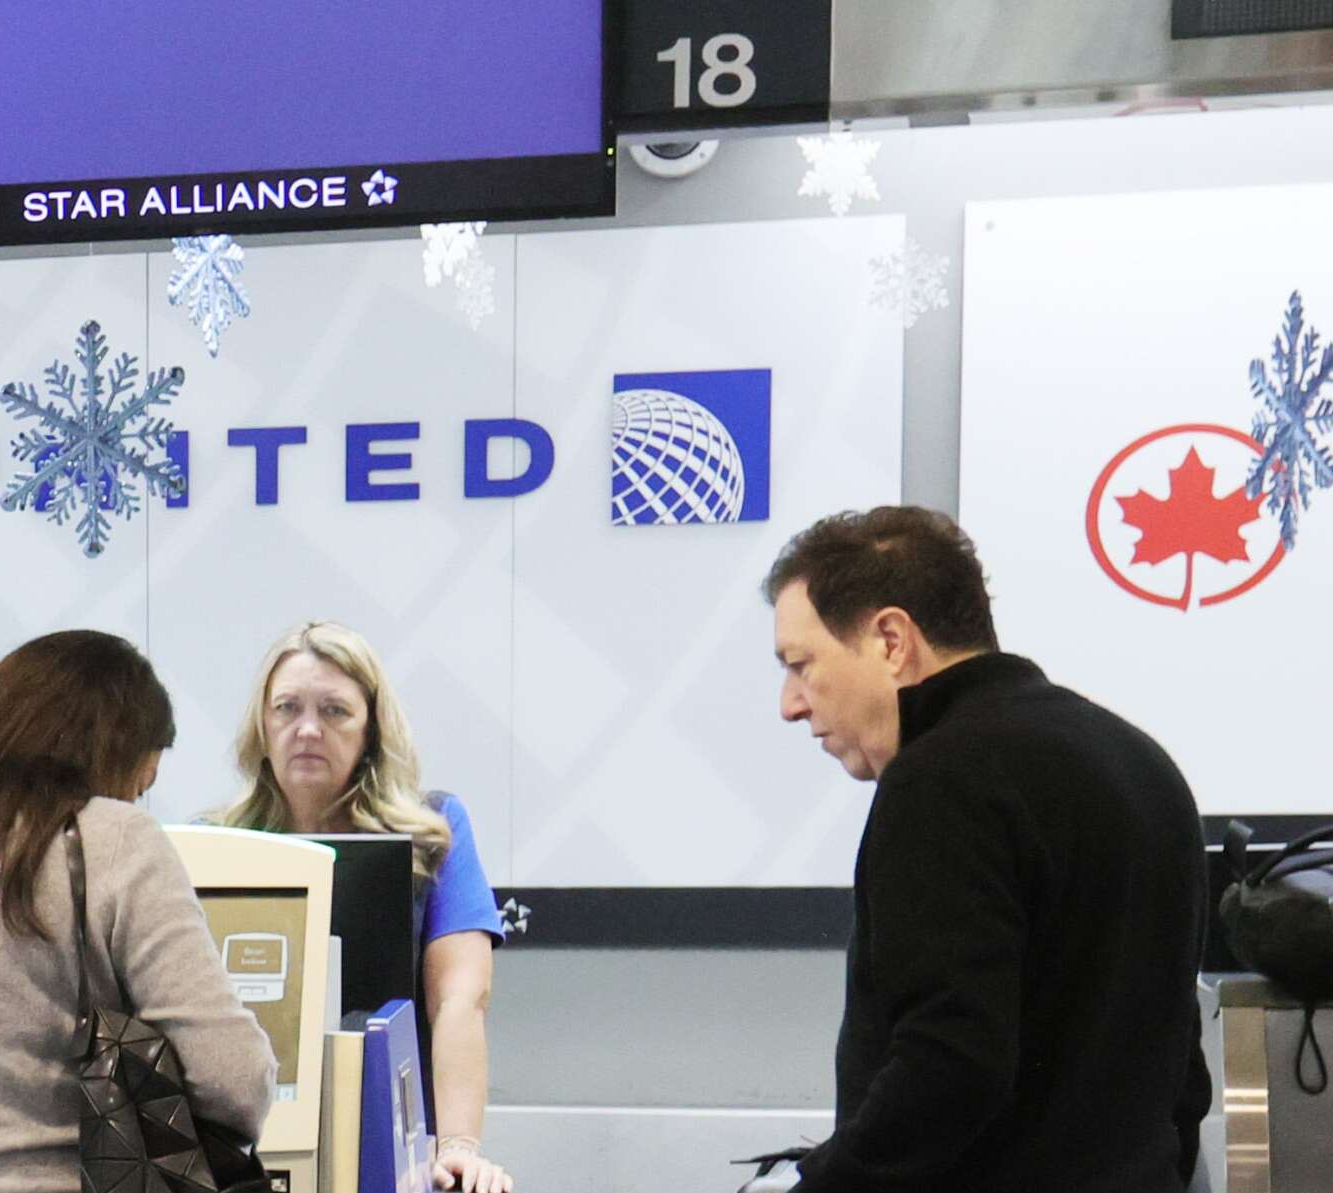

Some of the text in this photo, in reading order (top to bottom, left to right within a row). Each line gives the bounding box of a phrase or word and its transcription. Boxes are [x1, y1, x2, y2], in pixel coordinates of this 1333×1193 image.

[657, 34, 756, 108] 18
[23, 177, 346, 222] STAR ALLIANCE
